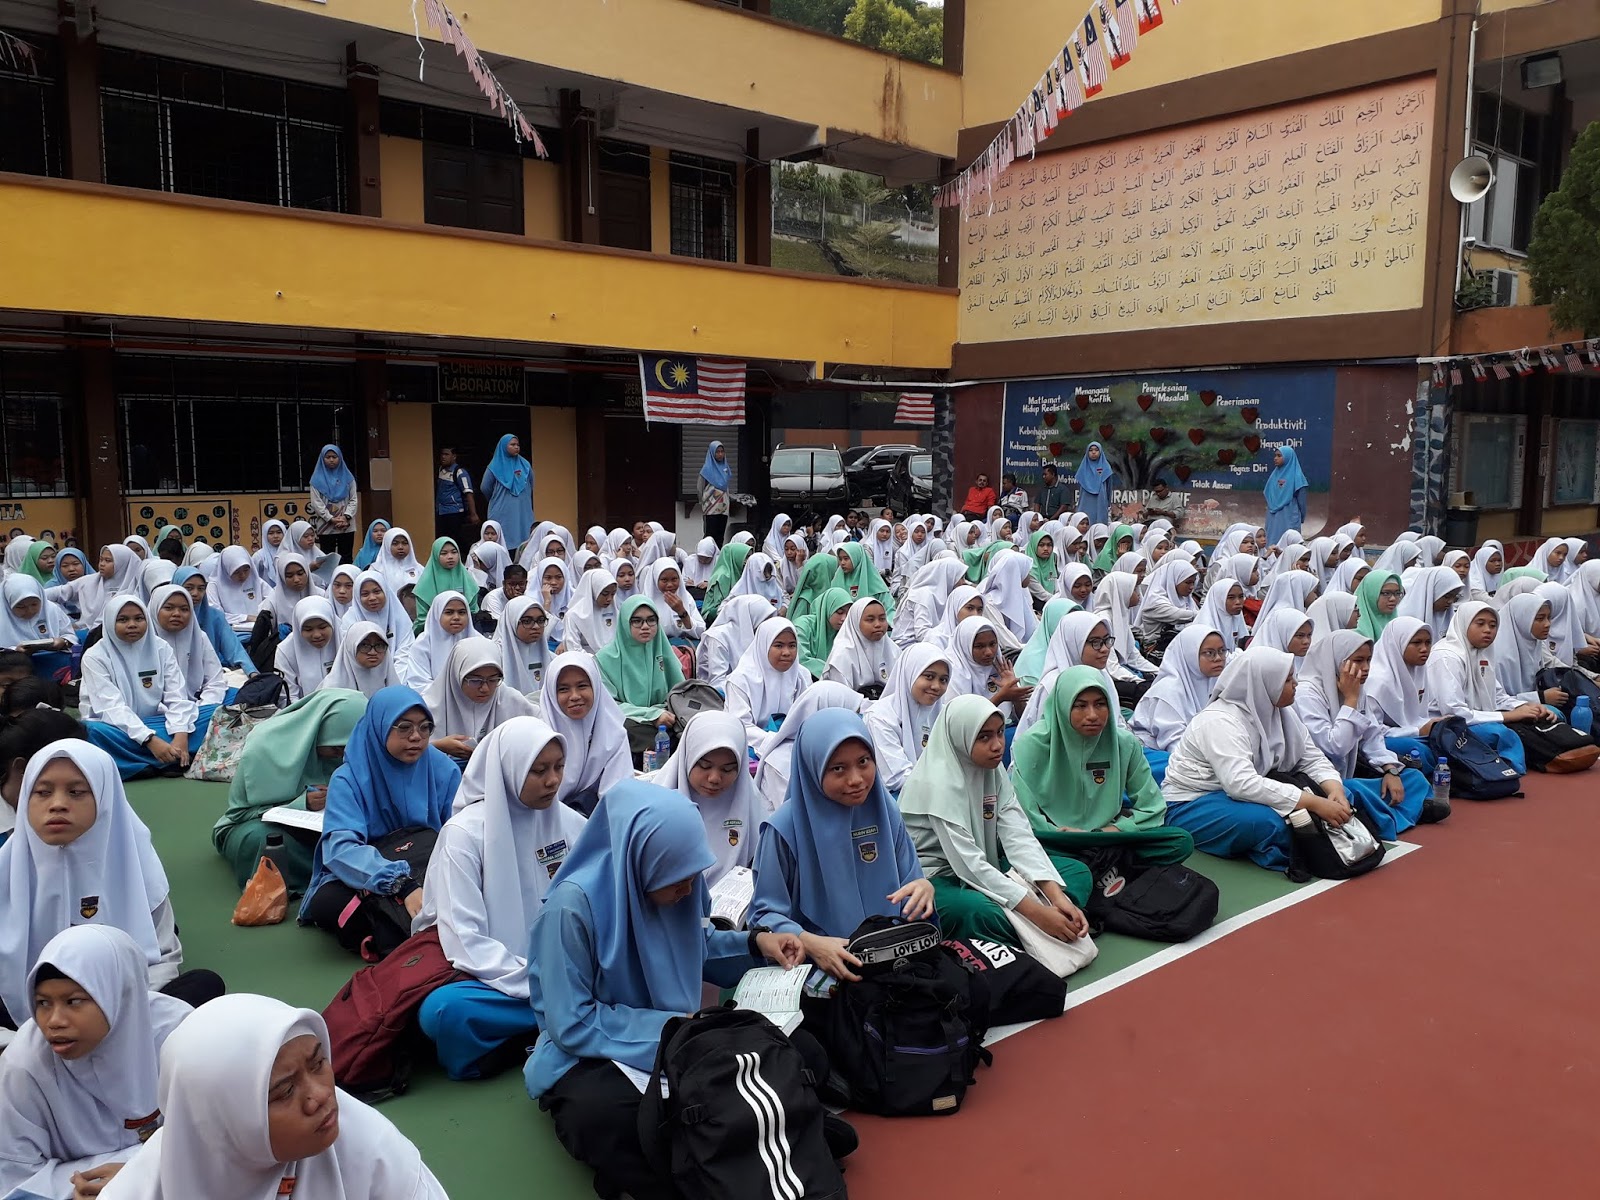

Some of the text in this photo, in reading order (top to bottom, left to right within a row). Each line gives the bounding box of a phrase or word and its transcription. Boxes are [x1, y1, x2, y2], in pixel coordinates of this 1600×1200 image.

[445, 376, 520, 393] LABORATORY
[1157, 393, 1189, 402] Masalah
[1216, 395, 1260, 406] Penerimaan
[1255, 418, 1307, 430] Produktiviti
[1286, 438, 1303, 448] Diri
[1229, 464, 1268, 475] Tegas Diri
[1058, 475, 1079, 484] Motiv
[893, 942, 917, 958] LOVE
